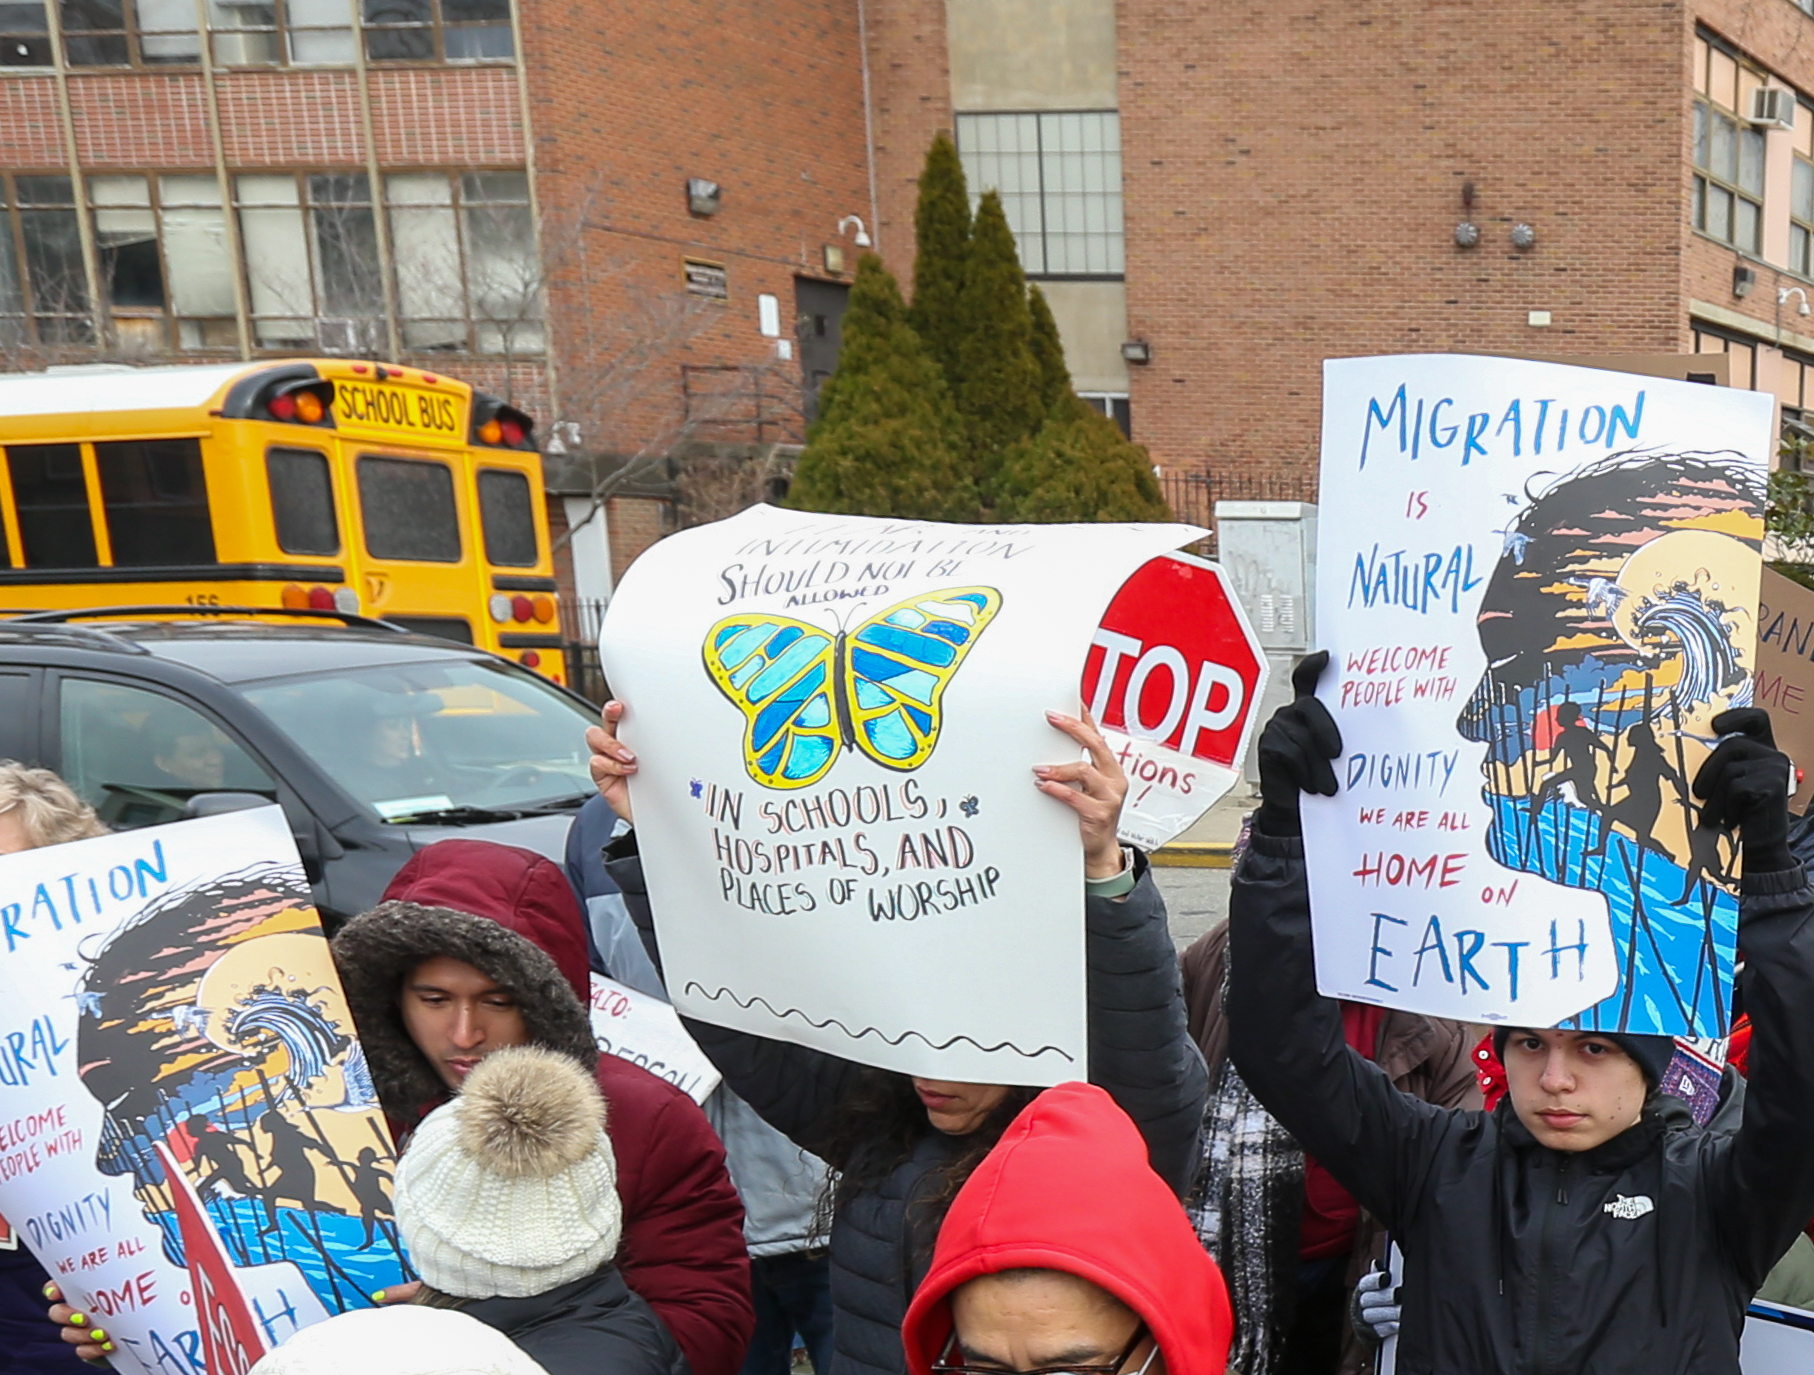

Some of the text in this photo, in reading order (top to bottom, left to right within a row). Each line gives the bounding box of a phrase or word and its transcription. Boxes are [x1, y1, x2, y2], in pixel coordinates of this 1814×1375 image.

[338, 385, 455, 431] SCHOOL BUS
[1359, 383, 1645, 471] MIGRATION
[1404, 490, 1430, 519] IS
[718, 560, 850, 606] SHOULD
[785, 584, 890, 608] ALLOWED
[1347, 541, 1483, 615] NATURAL
[1346, 646, 1451, 674] WELCOME
[1092, 626, 1244, 760] TOP
[1340, 676, 1458, 710] PEOPLE WITH
[1754, 669, 1806, 715] ME
[1115, 741, 1197, 795] tions
[1346, 749, 1460, 798] DIGNITY
[704, 780, 949, 836] IN SCHOOLS,
[1359, 808, 1472, 832] WE ARE ALL
[712, 825, 976, 878] HOSPITALS, AND
[0, 838, 168, 953] RATION
[719, 864, 1002, 923] PLACES OF WORSHIP
[1353, 852, 1520, 907] HOME ON
[1364, 912, 1589, 1003] EARTH
[0, 1014, 72, 1087] URAL
[0, 1103, 69, 1152] ELCOME
[0, 1127, 83, 1186] EOPLE WITH
[26, 1186, 112, 1251] DIGNITY
[55, 1236, 146, 1275] WE ARE ALL
[82, 1269, 191, 1318] HOME O
